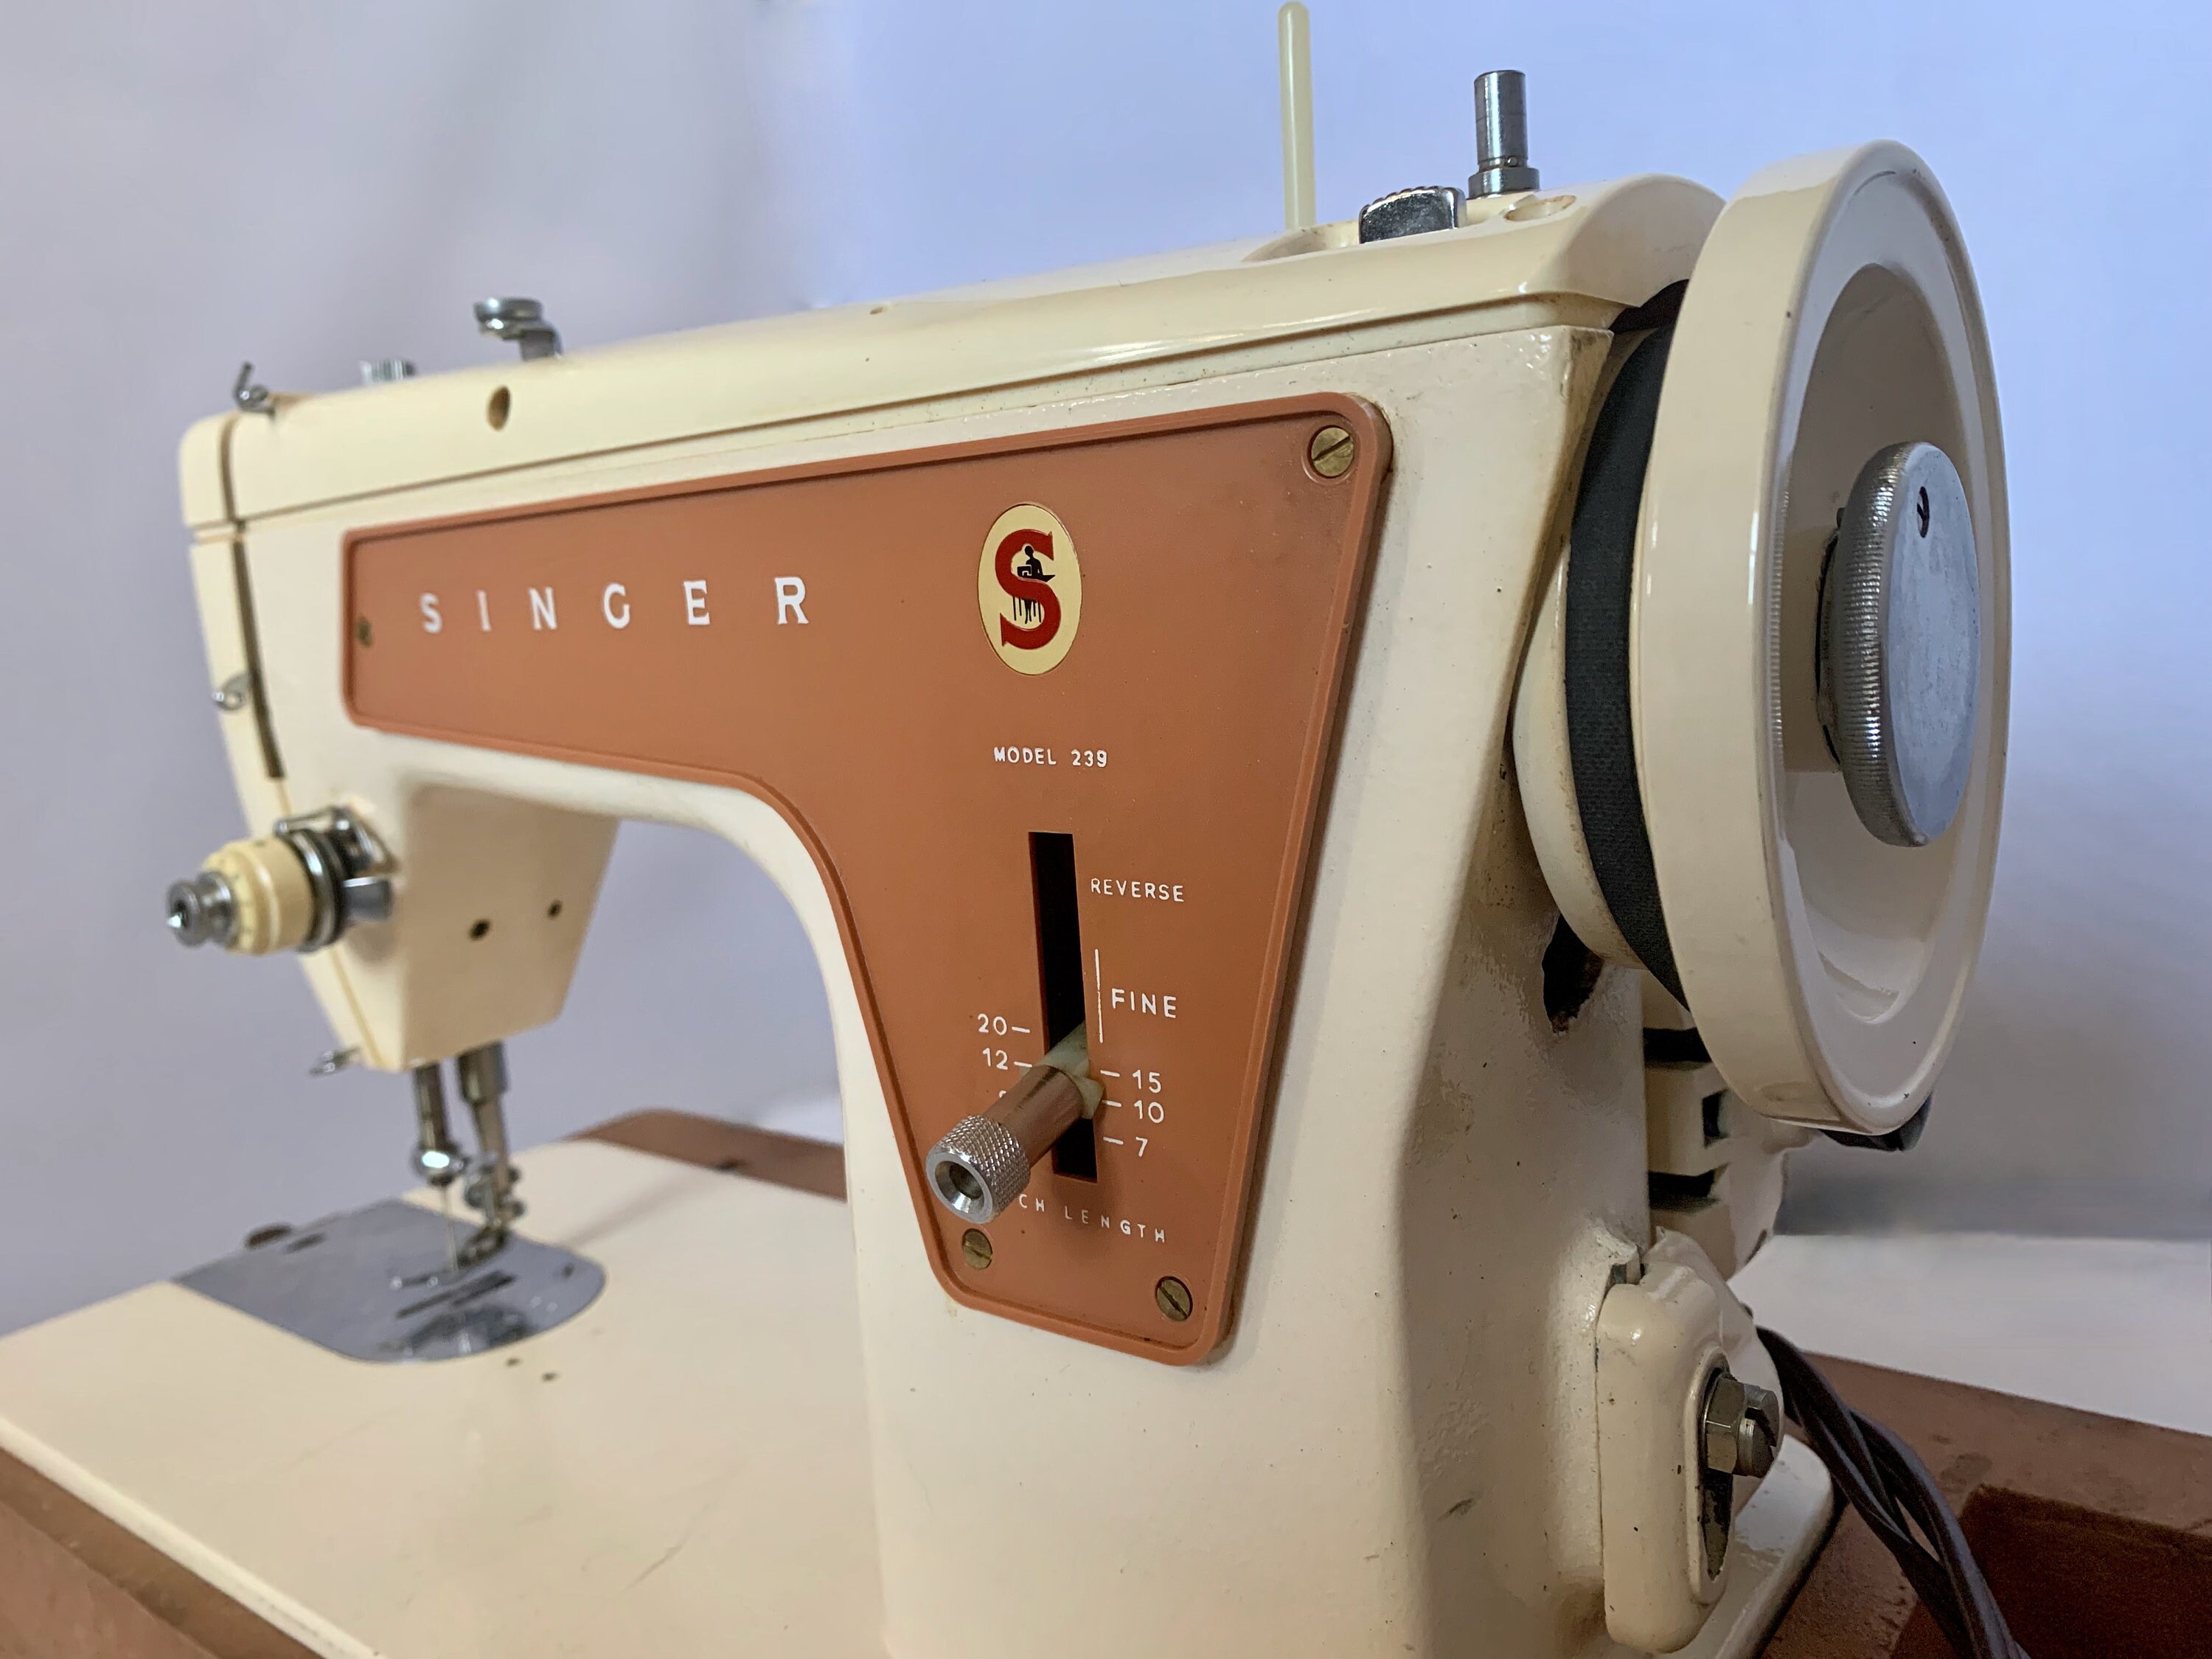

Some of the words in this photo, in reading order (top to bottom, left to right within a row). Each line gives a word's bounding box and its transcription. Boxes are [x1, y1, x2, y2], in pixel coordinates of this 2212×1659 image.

[995, 529, 1061, 650] S
[420, 576, 810, 633] SINGER
[993, 745, 1057, 765] MODEL
[1071, 748, 1107, 768] 239
[1091, 877, 1185, 902] REVERSE
[1111, 987, 1177, 1019] FINE
[977, 1013, 1007, 1036] 20
[982, 1047, 1009, 1071] 12
[1132, 1068, 1161, 1093] 15
[1133, 1099, 1164, 1124] 10
[1135, 1136, 1149, 1158] 7
[1065, 1206, 1165, 1243] LENGTH
